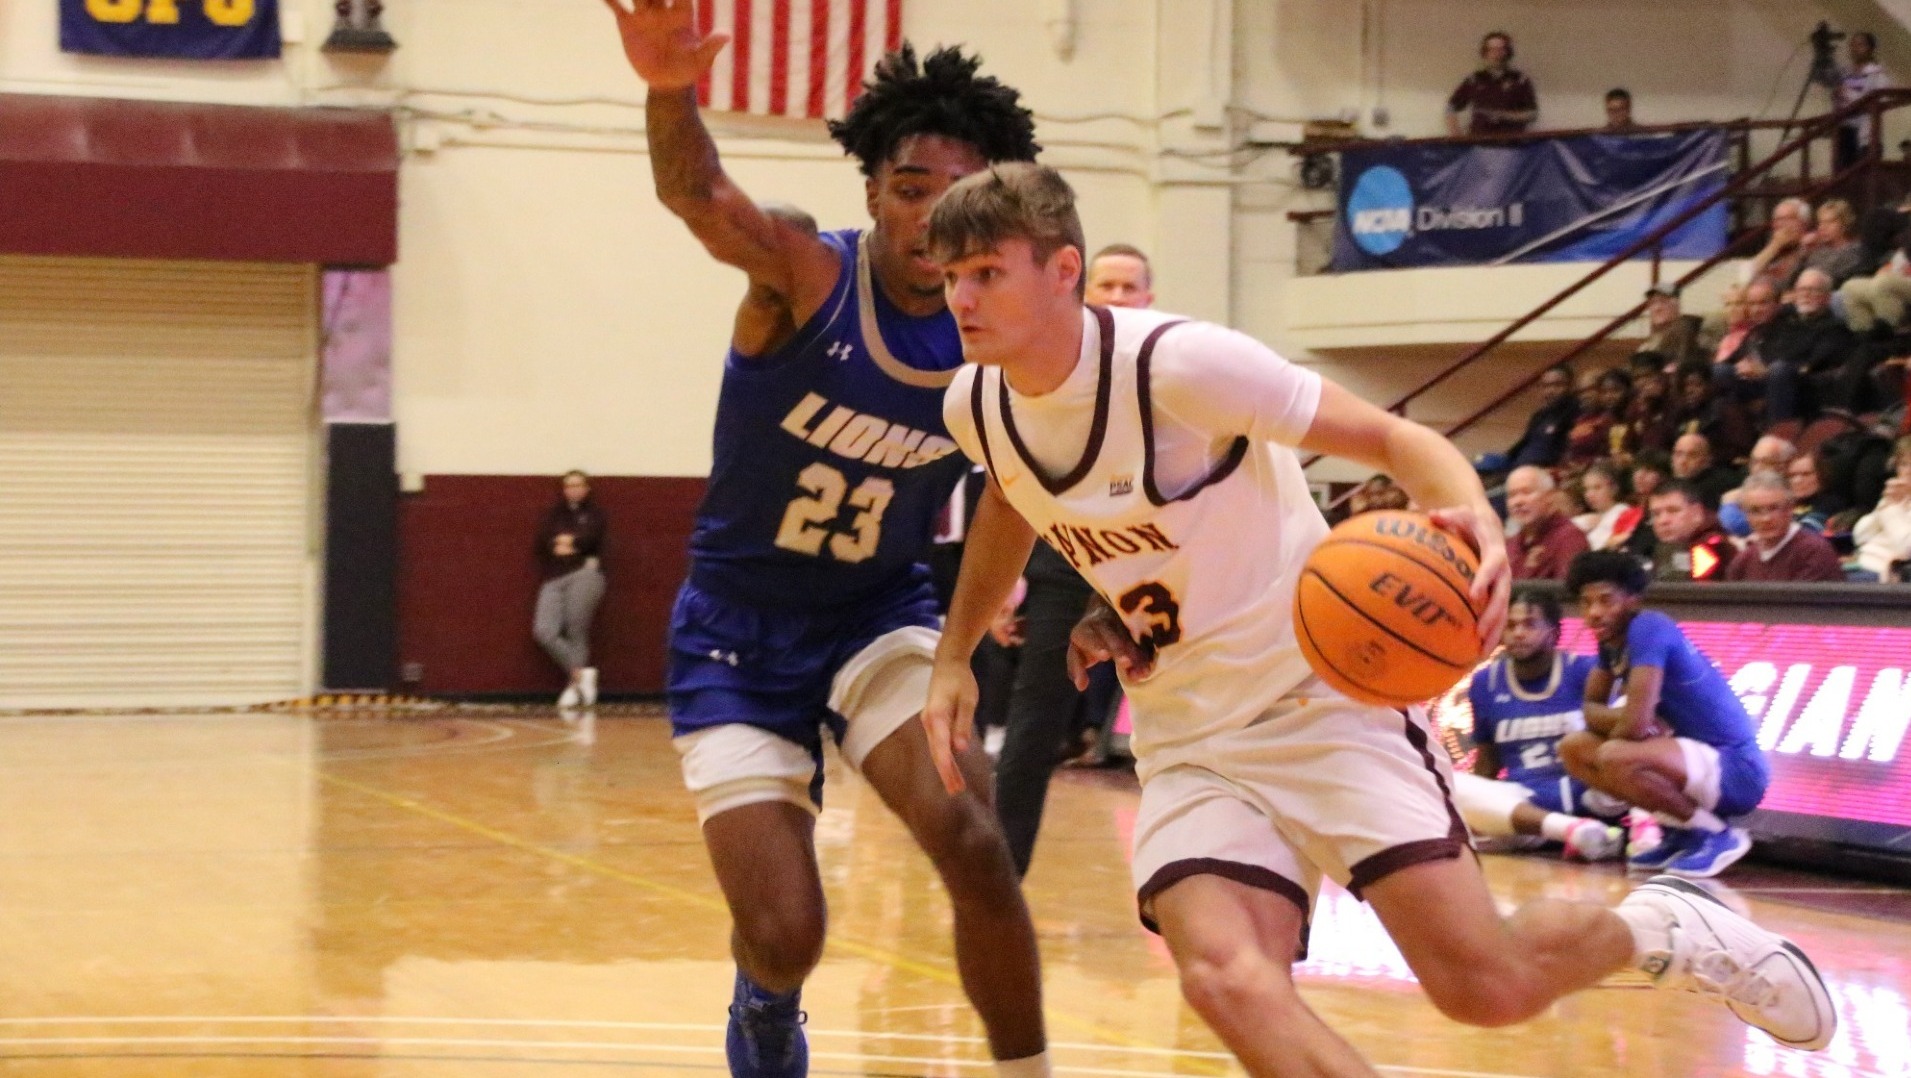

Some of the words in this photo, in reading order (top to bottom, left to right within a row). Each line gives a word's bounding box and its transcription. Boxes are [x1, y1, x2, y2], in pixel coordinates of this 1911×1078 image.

[1416, 206, 1506, 231] Division
[774, 462, 896, 564] 23
[1104, 581, 1181, 648] 3
[1520, 741, 1563, 770] 2
